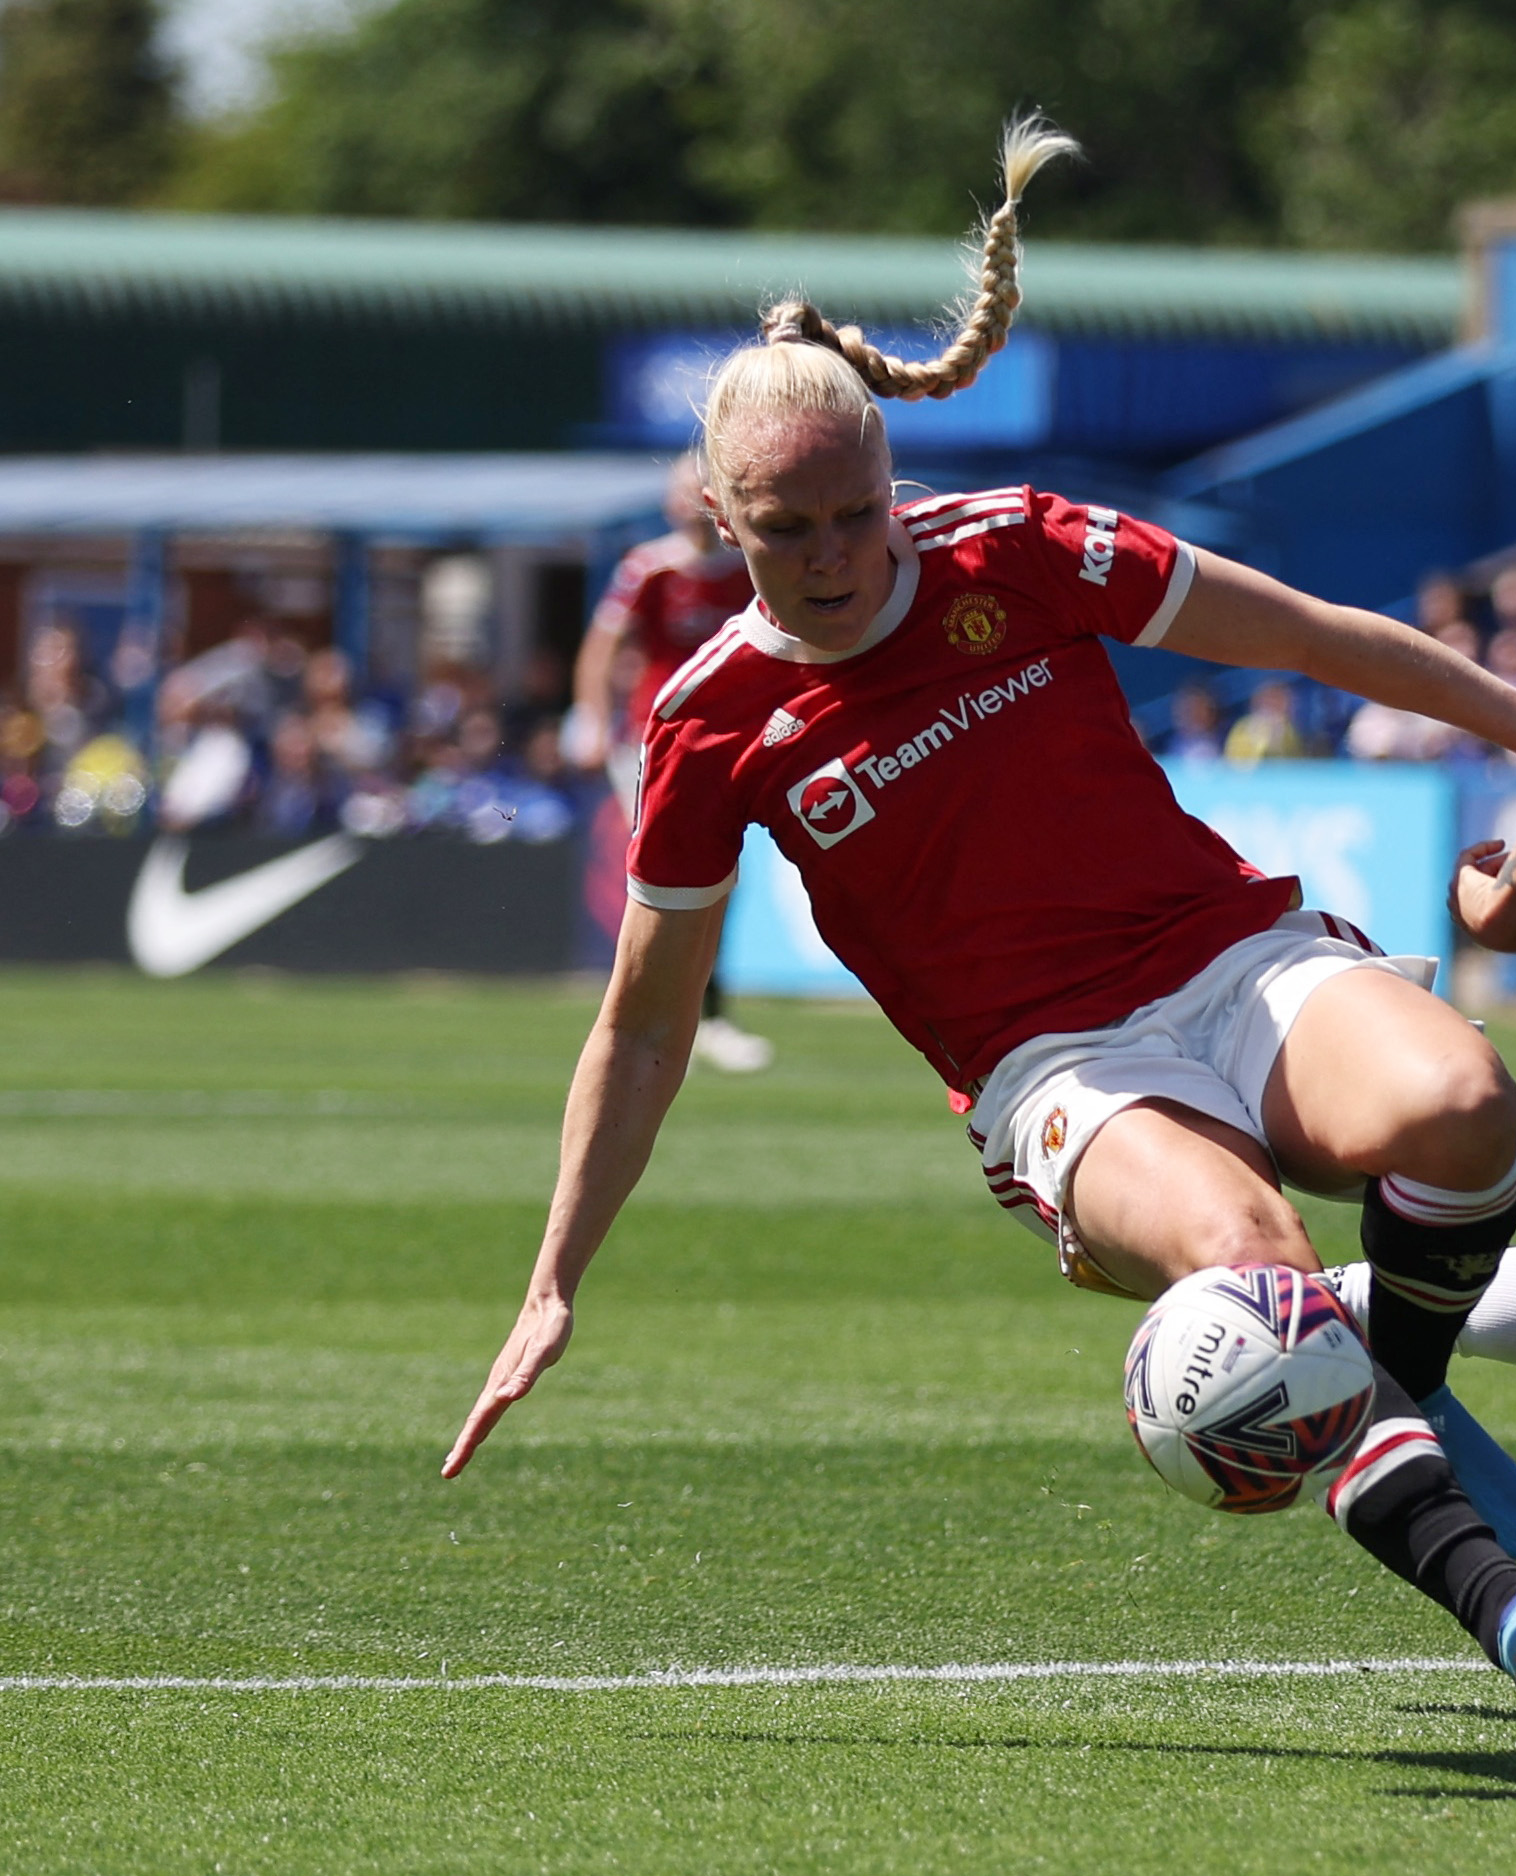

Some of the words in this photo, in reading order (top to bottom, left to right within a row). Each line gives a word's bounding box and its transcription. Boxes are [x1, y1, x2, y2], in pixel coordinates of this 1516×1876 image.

[763, 719, 805, 747] adidas
[854, 658, 1053, 789] TeamViewer
[1176, 1322, 1226, 1415] mitre
